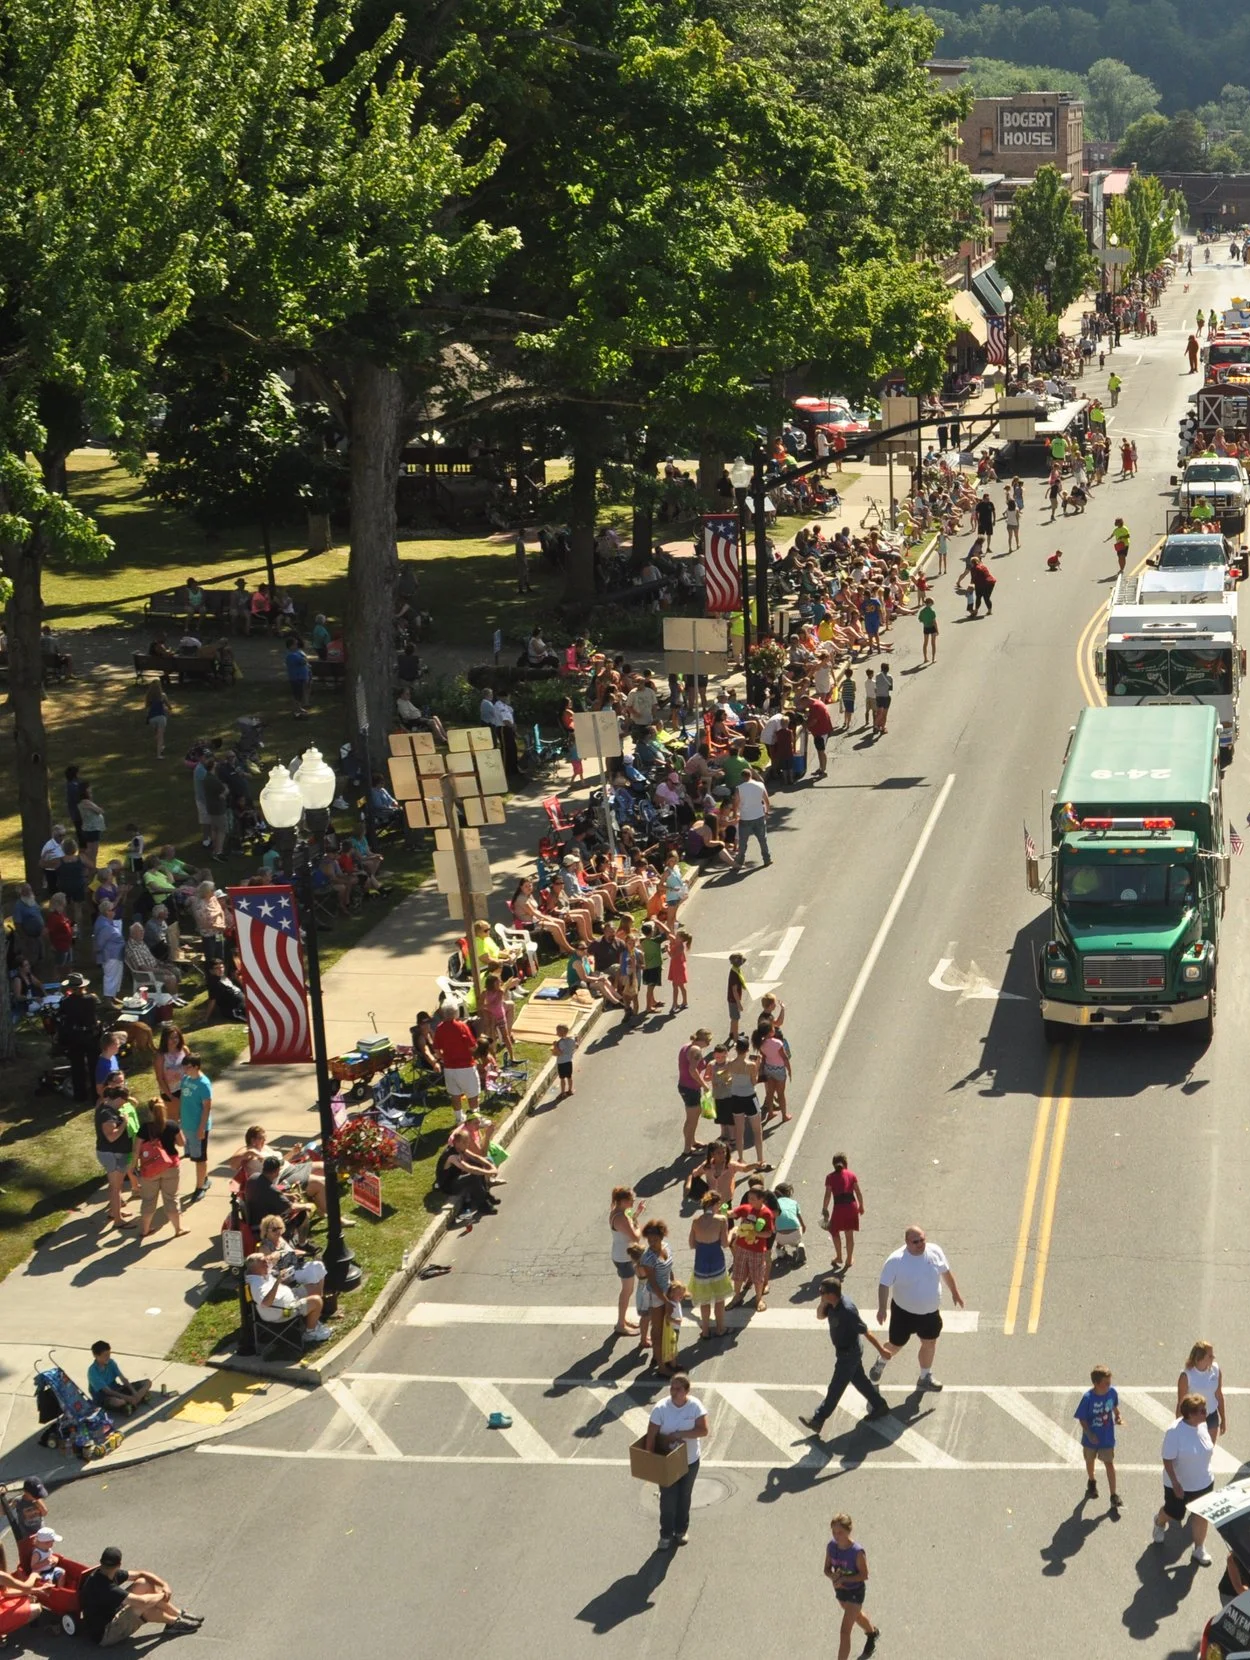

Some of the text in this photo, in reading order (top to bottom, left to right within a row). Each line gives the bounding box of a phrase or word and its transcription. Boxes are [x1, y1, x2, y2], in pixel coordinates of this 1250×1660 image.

[1003, 111, 1053, 127] BOGERT
[1003, 132, 1052, 145] HOUSE
[1225, 1607, 1250, 1631] AM/FM
